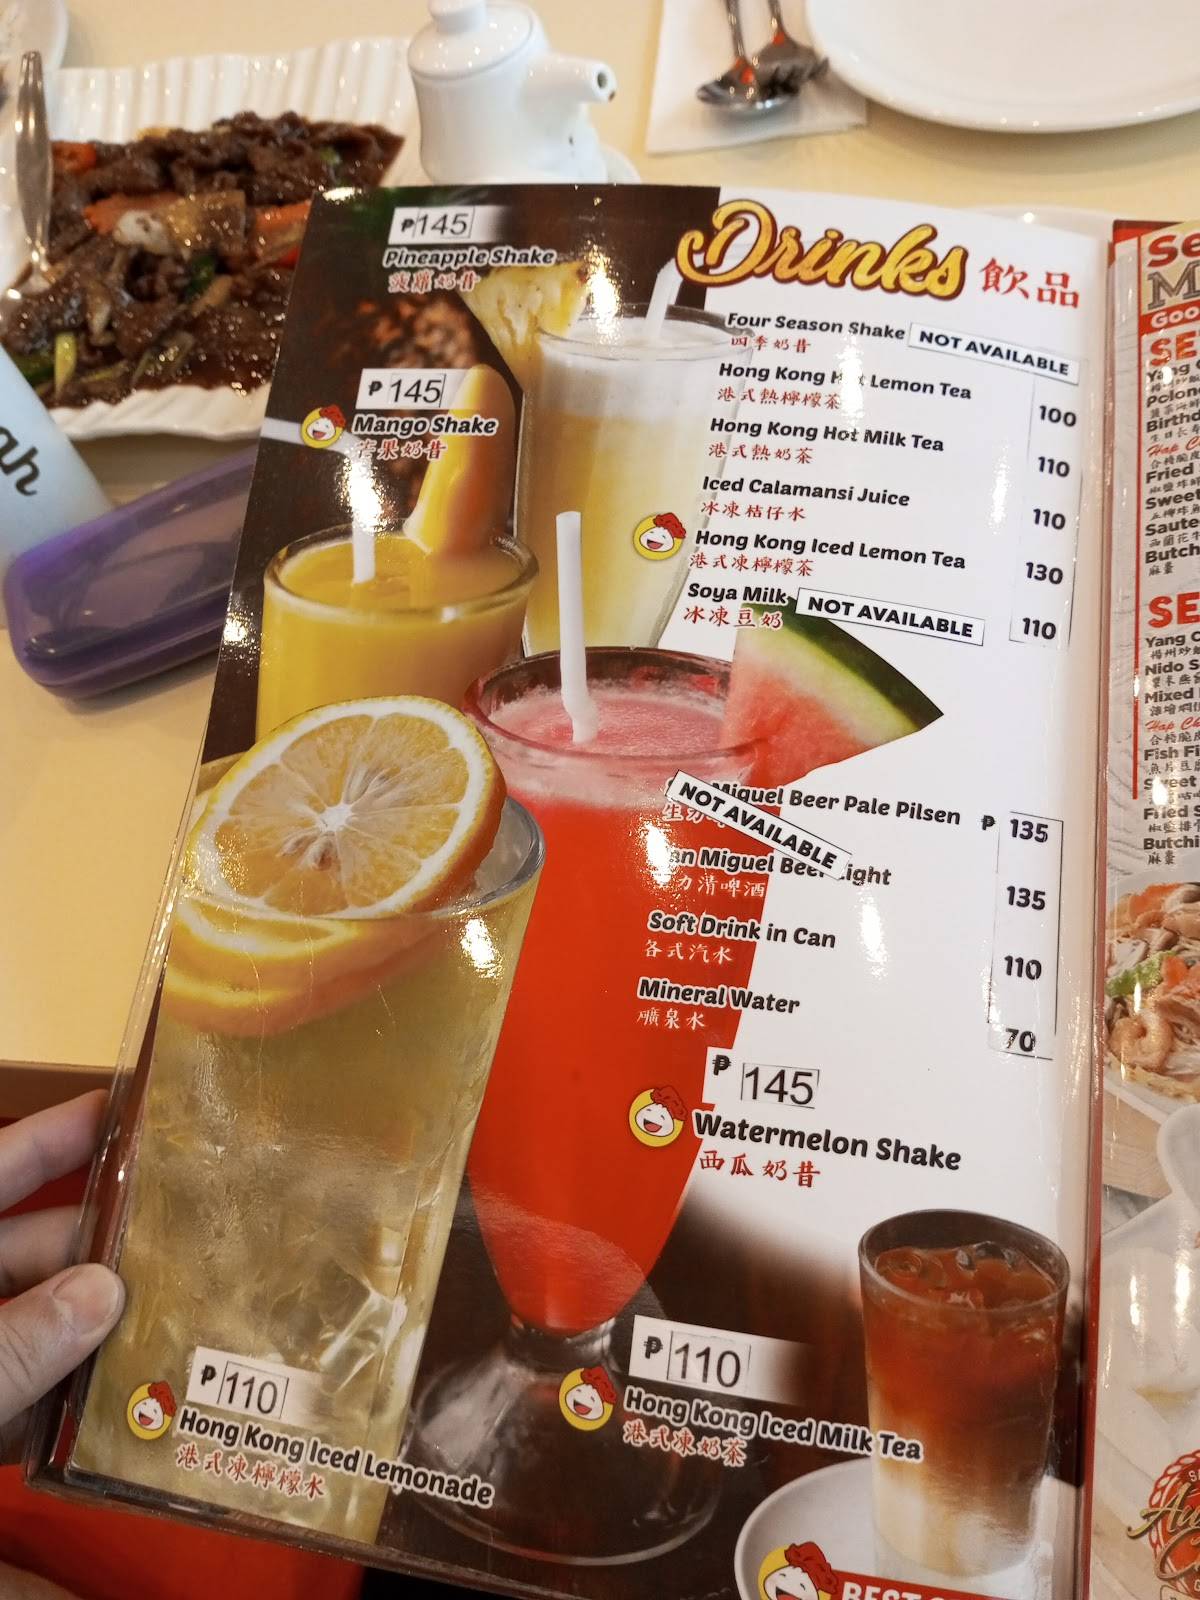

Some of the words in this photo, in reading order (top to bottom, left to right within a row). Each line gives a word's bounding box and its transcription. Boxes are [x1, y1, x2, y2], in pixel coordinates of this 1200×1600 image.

[385, 248, 488, 268] Pineapple
[491, 248, 555, 265] Shake
[675, 199, 968, 300] Drinks
[979, 258, 1080, 309] 飲品
[728, 312, 771, 330] Four
[775, 314, 843, 334] Season
[848, 320, 906, 342] Shake
[730, 334, 811, 354] 四季奶昔
[918, 330, 962, 351] NOT
[965, 341, 1070, 376] AVAILABLE
[1150, 330, 1200, 367] SE
[390, 379, 442, 404] 145
[719, 363, 770, 382] Hong
[775, 366, 826, 386] Kong
[870, 375, 934, 395] Lemon
[940, 381, 972, 400] Tea
[717, 386, 841, 410] 港式熱檸檬茶
[354, 416, 427, 436] Mango
[432, 416, 497, 434] Shake
[1039, 405, 1077, 427] 100
[710, 418, 762, 438] Hong
[767, 422, 818, 441] Kong
[823, 425, 860, 442] Hot
[864, 430, 907, 449] Milk
[911, 434, 944, 452] Tea
[356, 439, 446, 460] 芒果奶昔
[708, 443, 814, 465] 港式熱奶茶
[1037, 456, 1071, 478] 110
[1146, 462, 1194, 484] Fried
[702, 476, 744, 493] Iced
[748, 479, 854, 502] Calamansi
[857, 488, 910, 507] Juice
[1033, 508, 1066, 531] 110
[695, 530, 749, 551] Hong
[753, 535, 806, 555] Kong
[811, 538, 854, 557] Iced
[859, 544, 926, 565] Lemon
[932, 550, 966, 569] Tea
[689, 552, 814, 577] 港式凍檸檬茶
[1025, 561, 1064, 585] 130
[687, 583, 738, 602] Soya
[742, 586, 788, 604] Milk
[683, 605, 783, 629] 冰凍豆奶
[807, 596, 854, 616] NOT
[857, 604, 974, 639] AVAILABLE
[1022, 617, 1057, 641] 110
[1145, 634, 1186, 648] Yang
[1144, 661, 1184, 676] Nido
[1144, 687, 1194, 704] Mixed
[1144, 746, 1179, 761] Fish
[1144, 775, 1197, 791] Seet
[789, 789, 840, 811] Beer
[843, 795, 890, 817] Pale
[896, 800, 960, 825] Pilsen
[679, 781, 726, 813] NOT
[723, 807, 837, 870] AVAILABLE
[1010, 818, 1049, 843] 135
[1144, 835, 1200, 850] Butchi
[700, 849, 774, 873] Miguel
[780, 857, 826, 878] Bee
[838, 863, 892, 887] ight
[1006, 886, 1046, 911] 135
[649, 912, 696, 933] Soft
[700, 916, 761, 940] Drink
[766, 923, 787, 943] in
[793, 927, 836, 948] Can
[645, 939, 733, 965] 各式汽水
[1004, 955, 1042, 980] 110
[639, 978, 725, 1006] Mineral
[731, 988, 800, 1014] Water
[637, 1007, 705, 1031] 礦泉水
[1004, 1028, 1036, 1052] 70
[744, 1066, 814, 1106] 145
[694, 1112, 868, 1157] Watermelon
[875, 1138, 962, 1171] Shake
[699, 1150, 821, 1188] 西瓜奶昔
[673, 1342, 741, 1388] 110
[224, 1371, 278, 1415] 110
[625, 1387, 688, 1424] Hong
[692, 1402, 756, 1438] Kong
[761, 1414, 813, 1442] Iced
[818, 1423, 873, 1454] Milk
[879, 1433, 922, 1460] Tea
[623, 1420, 748, 1467] 港式凍奶茶
[178, 1409, 240, 1446] Hong
[244, 1424, 304, 1462] Kong
[309, 1441, 361, 1473] Iced
[364, 1454, 494, 1506] Lemonade
[176, 1444, 326, 1500] 港式凍檸檬水
